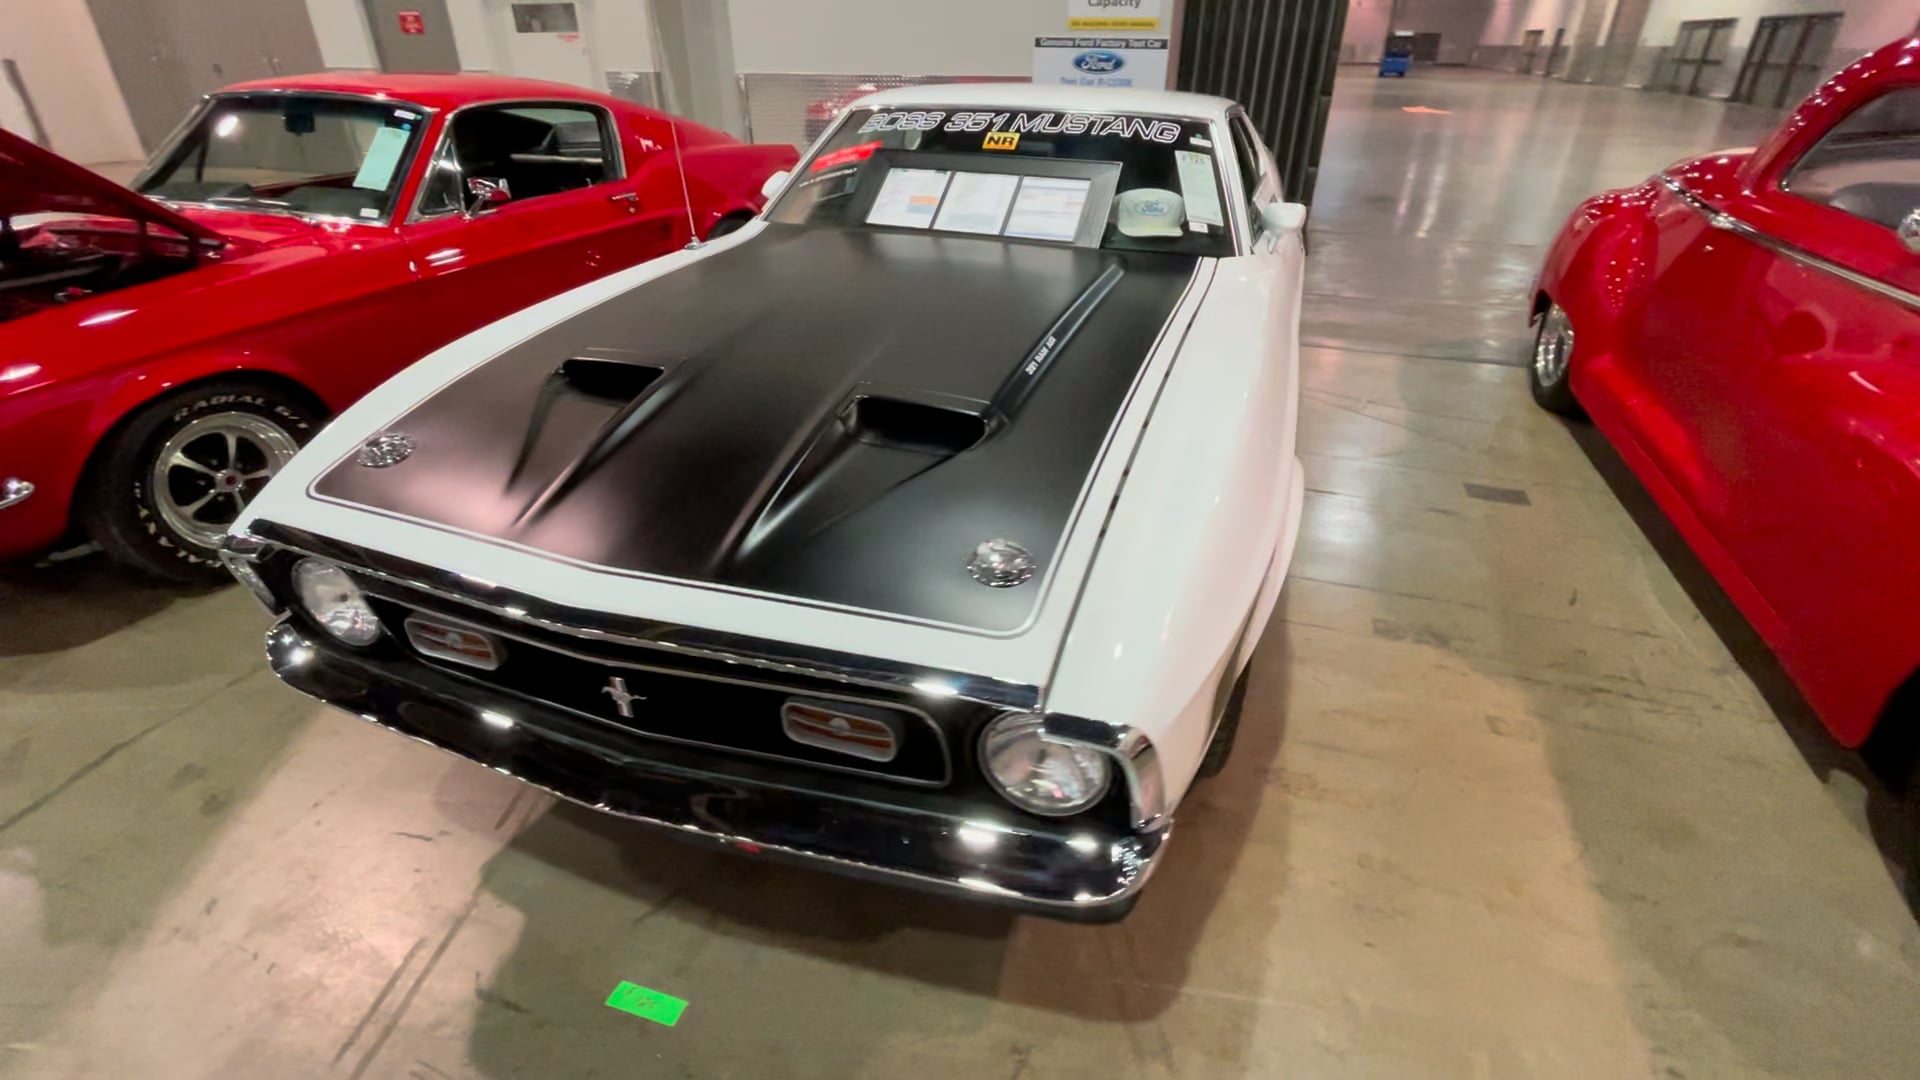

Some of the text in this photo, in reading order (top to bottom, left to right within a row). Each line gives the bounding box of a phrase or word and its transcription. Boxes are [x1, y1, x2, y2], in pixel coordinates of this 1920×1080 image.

[1088, 0, 1141, 8] Capacity
[1075, 39, 1094, 47] Ford
[1096, 39, 1126, 48] Factory
[1129, 40, 1145, 48] Test
[1147, 40, 1162, 48] Car
[1081, 54, 1116, 71] Ford
[943, 112, 1010, 132] 351
[1009, 112, 1181, 144] MUSTANG
[986, 135, 1015, 146] NR
[173, 395, 265, 422] RADIAL
